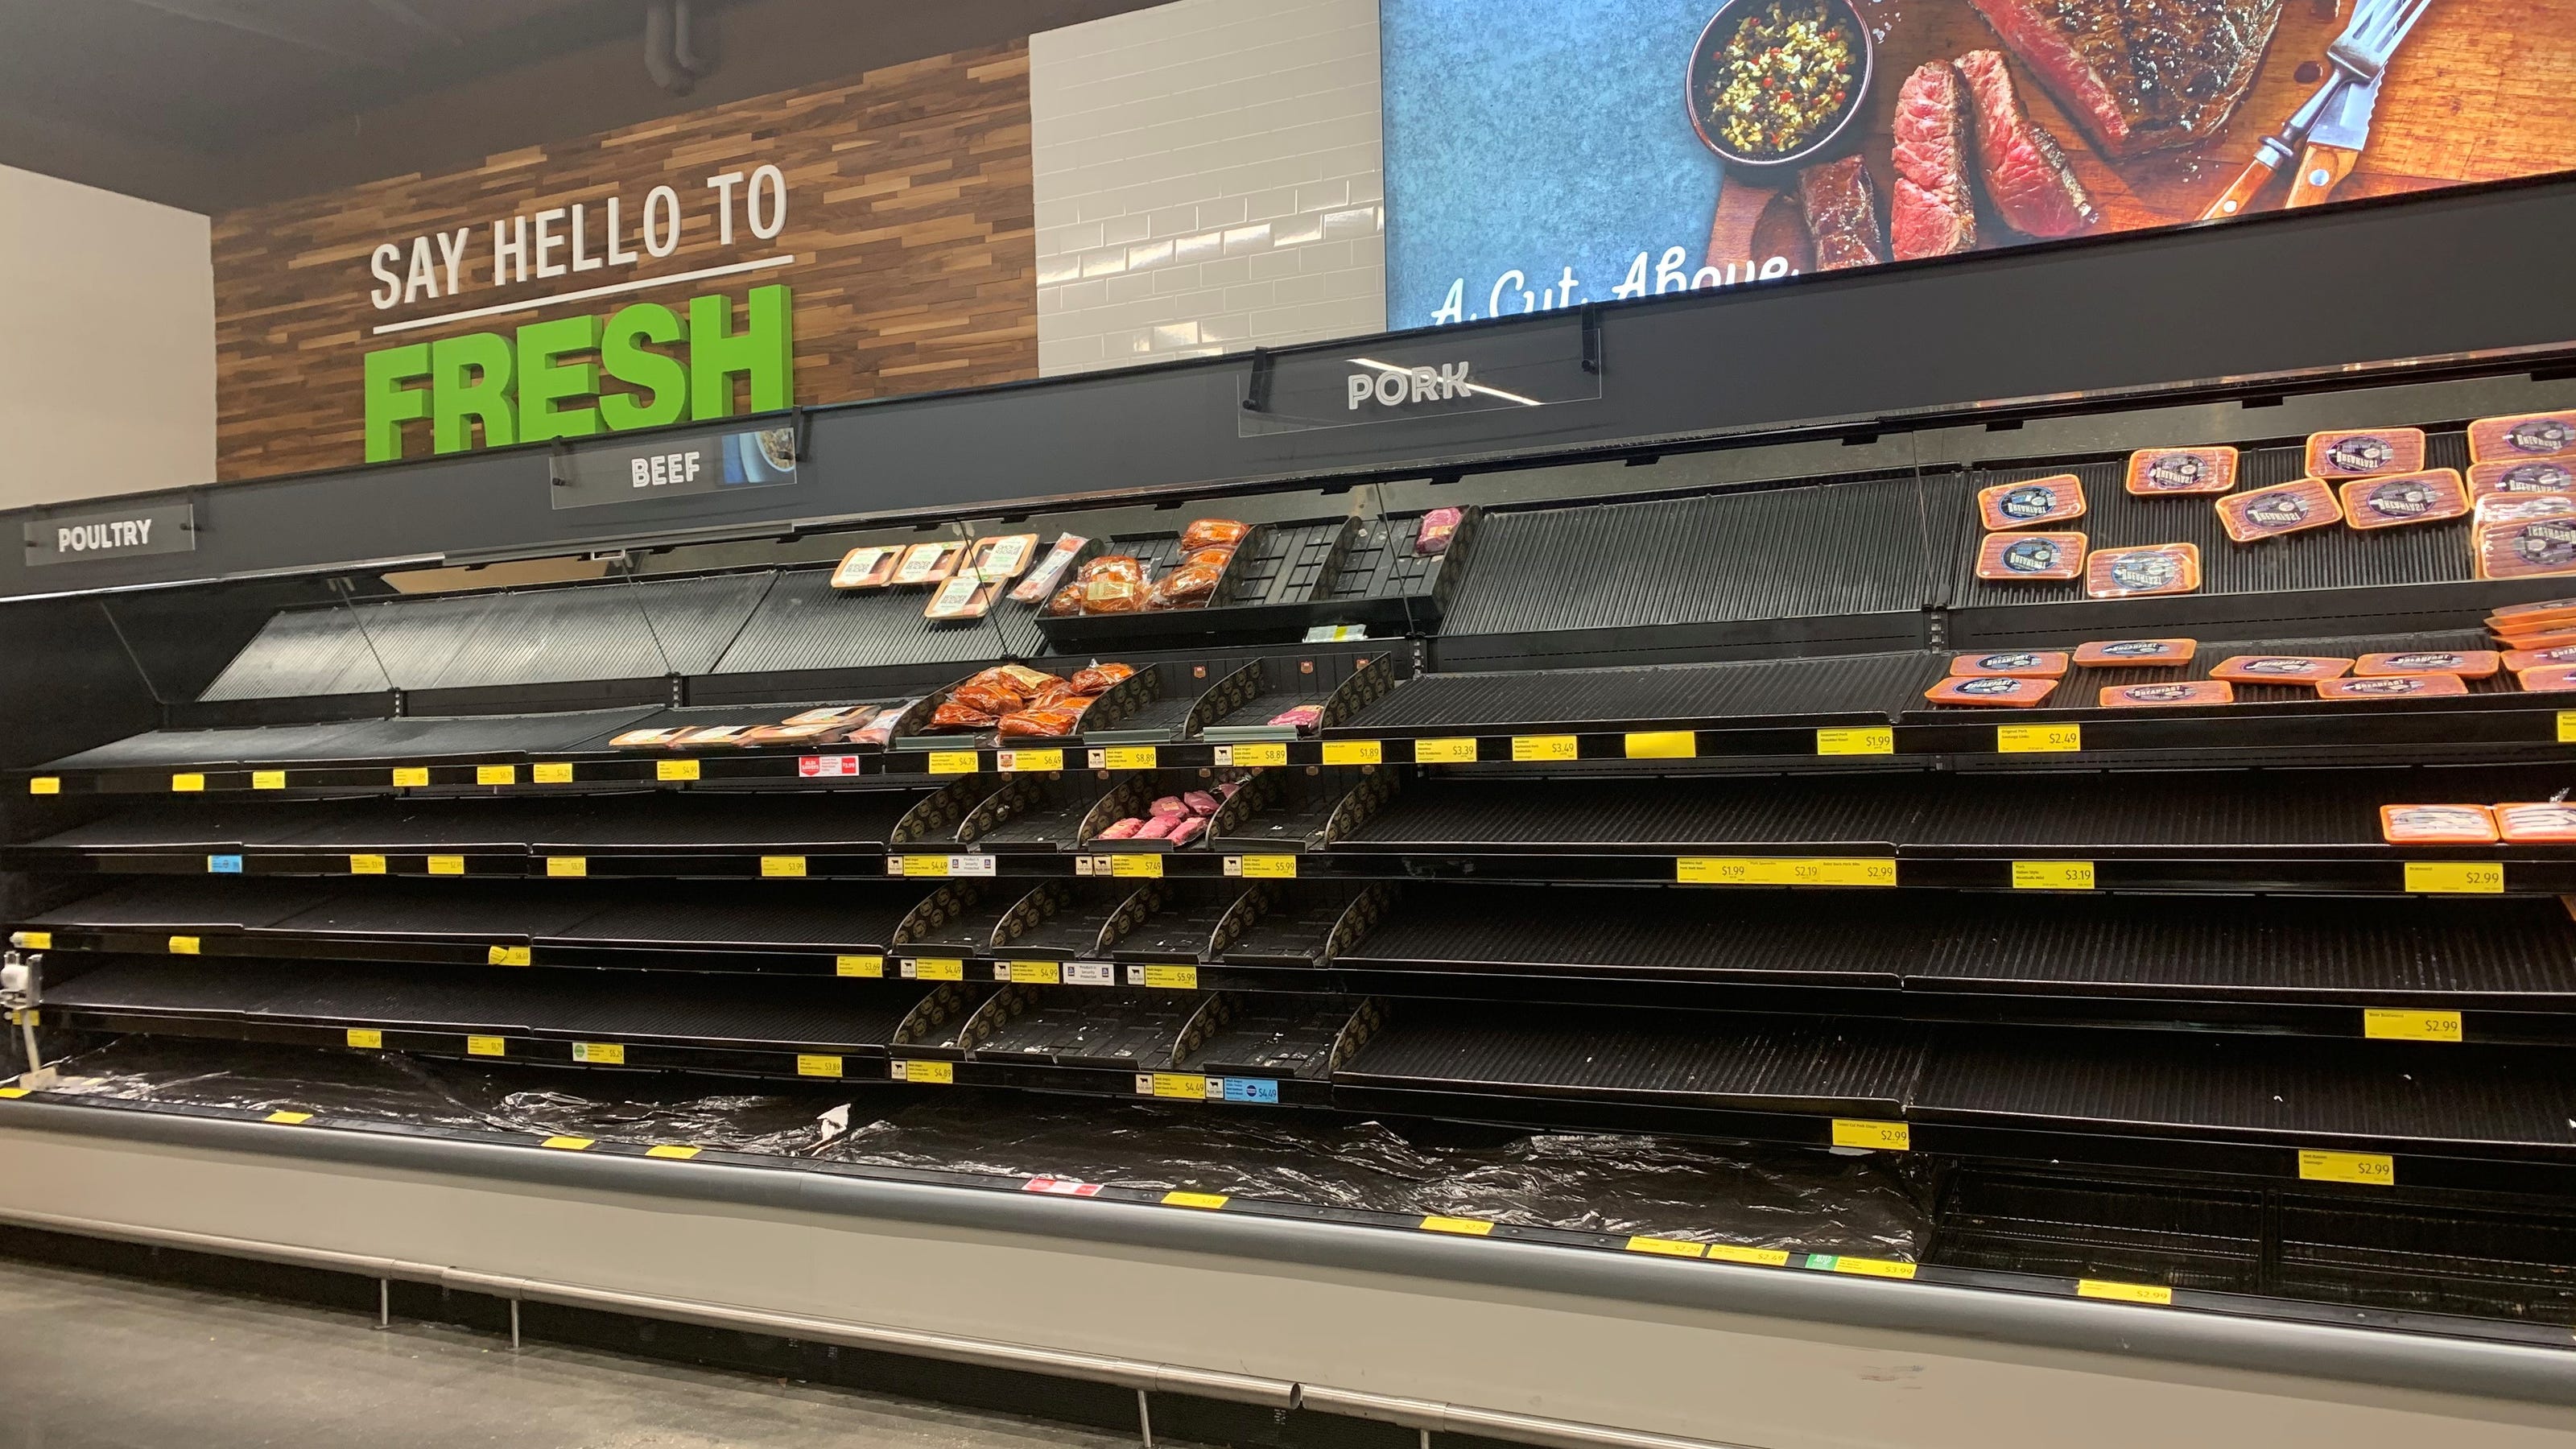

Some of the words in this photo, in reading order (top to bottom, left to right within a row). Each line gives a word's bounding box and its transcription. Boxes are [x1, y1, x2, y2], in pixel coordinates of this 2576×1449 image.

[370, 228, 469, 310] SAY
[493, 185, 680, 286] HELLO
[707, 164, 787, 245] TO
[365, 284, 793, 464] FRESH
[1348, 361, 1472, 410] PORK
[631, 451, 700, 488] BEEF
[58, 518, 151, 552] POULTRY
[1866, 736, 1890, 746] $1.99
[2049, 733, 2077, 744] $2.49
[1360, 748, 1379, 758] $1.89
[1452, 745, 1474, 755] $3.39
[1552, 743, 1575, 753] $3.49
[1136, 753, 1155, 762] $8.89
[1265, 750, 1285, 759] $8.89
[959, 757, 976, 766] $4.79
[1044, 756, 1062, 765] $6.49
[931, 861, 947, 869] $4.49
[1146, 861, 1161, 870] $7.49
[1275, 862, 1294, 871] $5.99
[1722, 866, 1745, 877] $1.99
[1794, 866, 1818, 877] $2.19
[1868, 867, 1893, 877] $2.99
[2066, 869, 2091, 880] $3.19
[2466, 872, 2500, 884] $2.99
[865, 963, 881, 971] $3.69
[1041, 968, 1058, 976] $4.99
[1177, 972, 1195, 981] $5.99
[2425, 1020, 2458, 1032] $2.99
[825, 1063, 840, 1071] $3.89
[935, 1068, 952, 1077] $4.89
[1185, 1082, 1204, 1092] $4.49
[1258, 1088, 1277, 1098] $4.49
[1881, 1129, 1907, 1141] $2.99
[2358, 1162, 2390, 1175] $2.99
[1885, 1265, 1913, 1275] $3.99
[2136, 1290, 2168, 1299] $2.99
